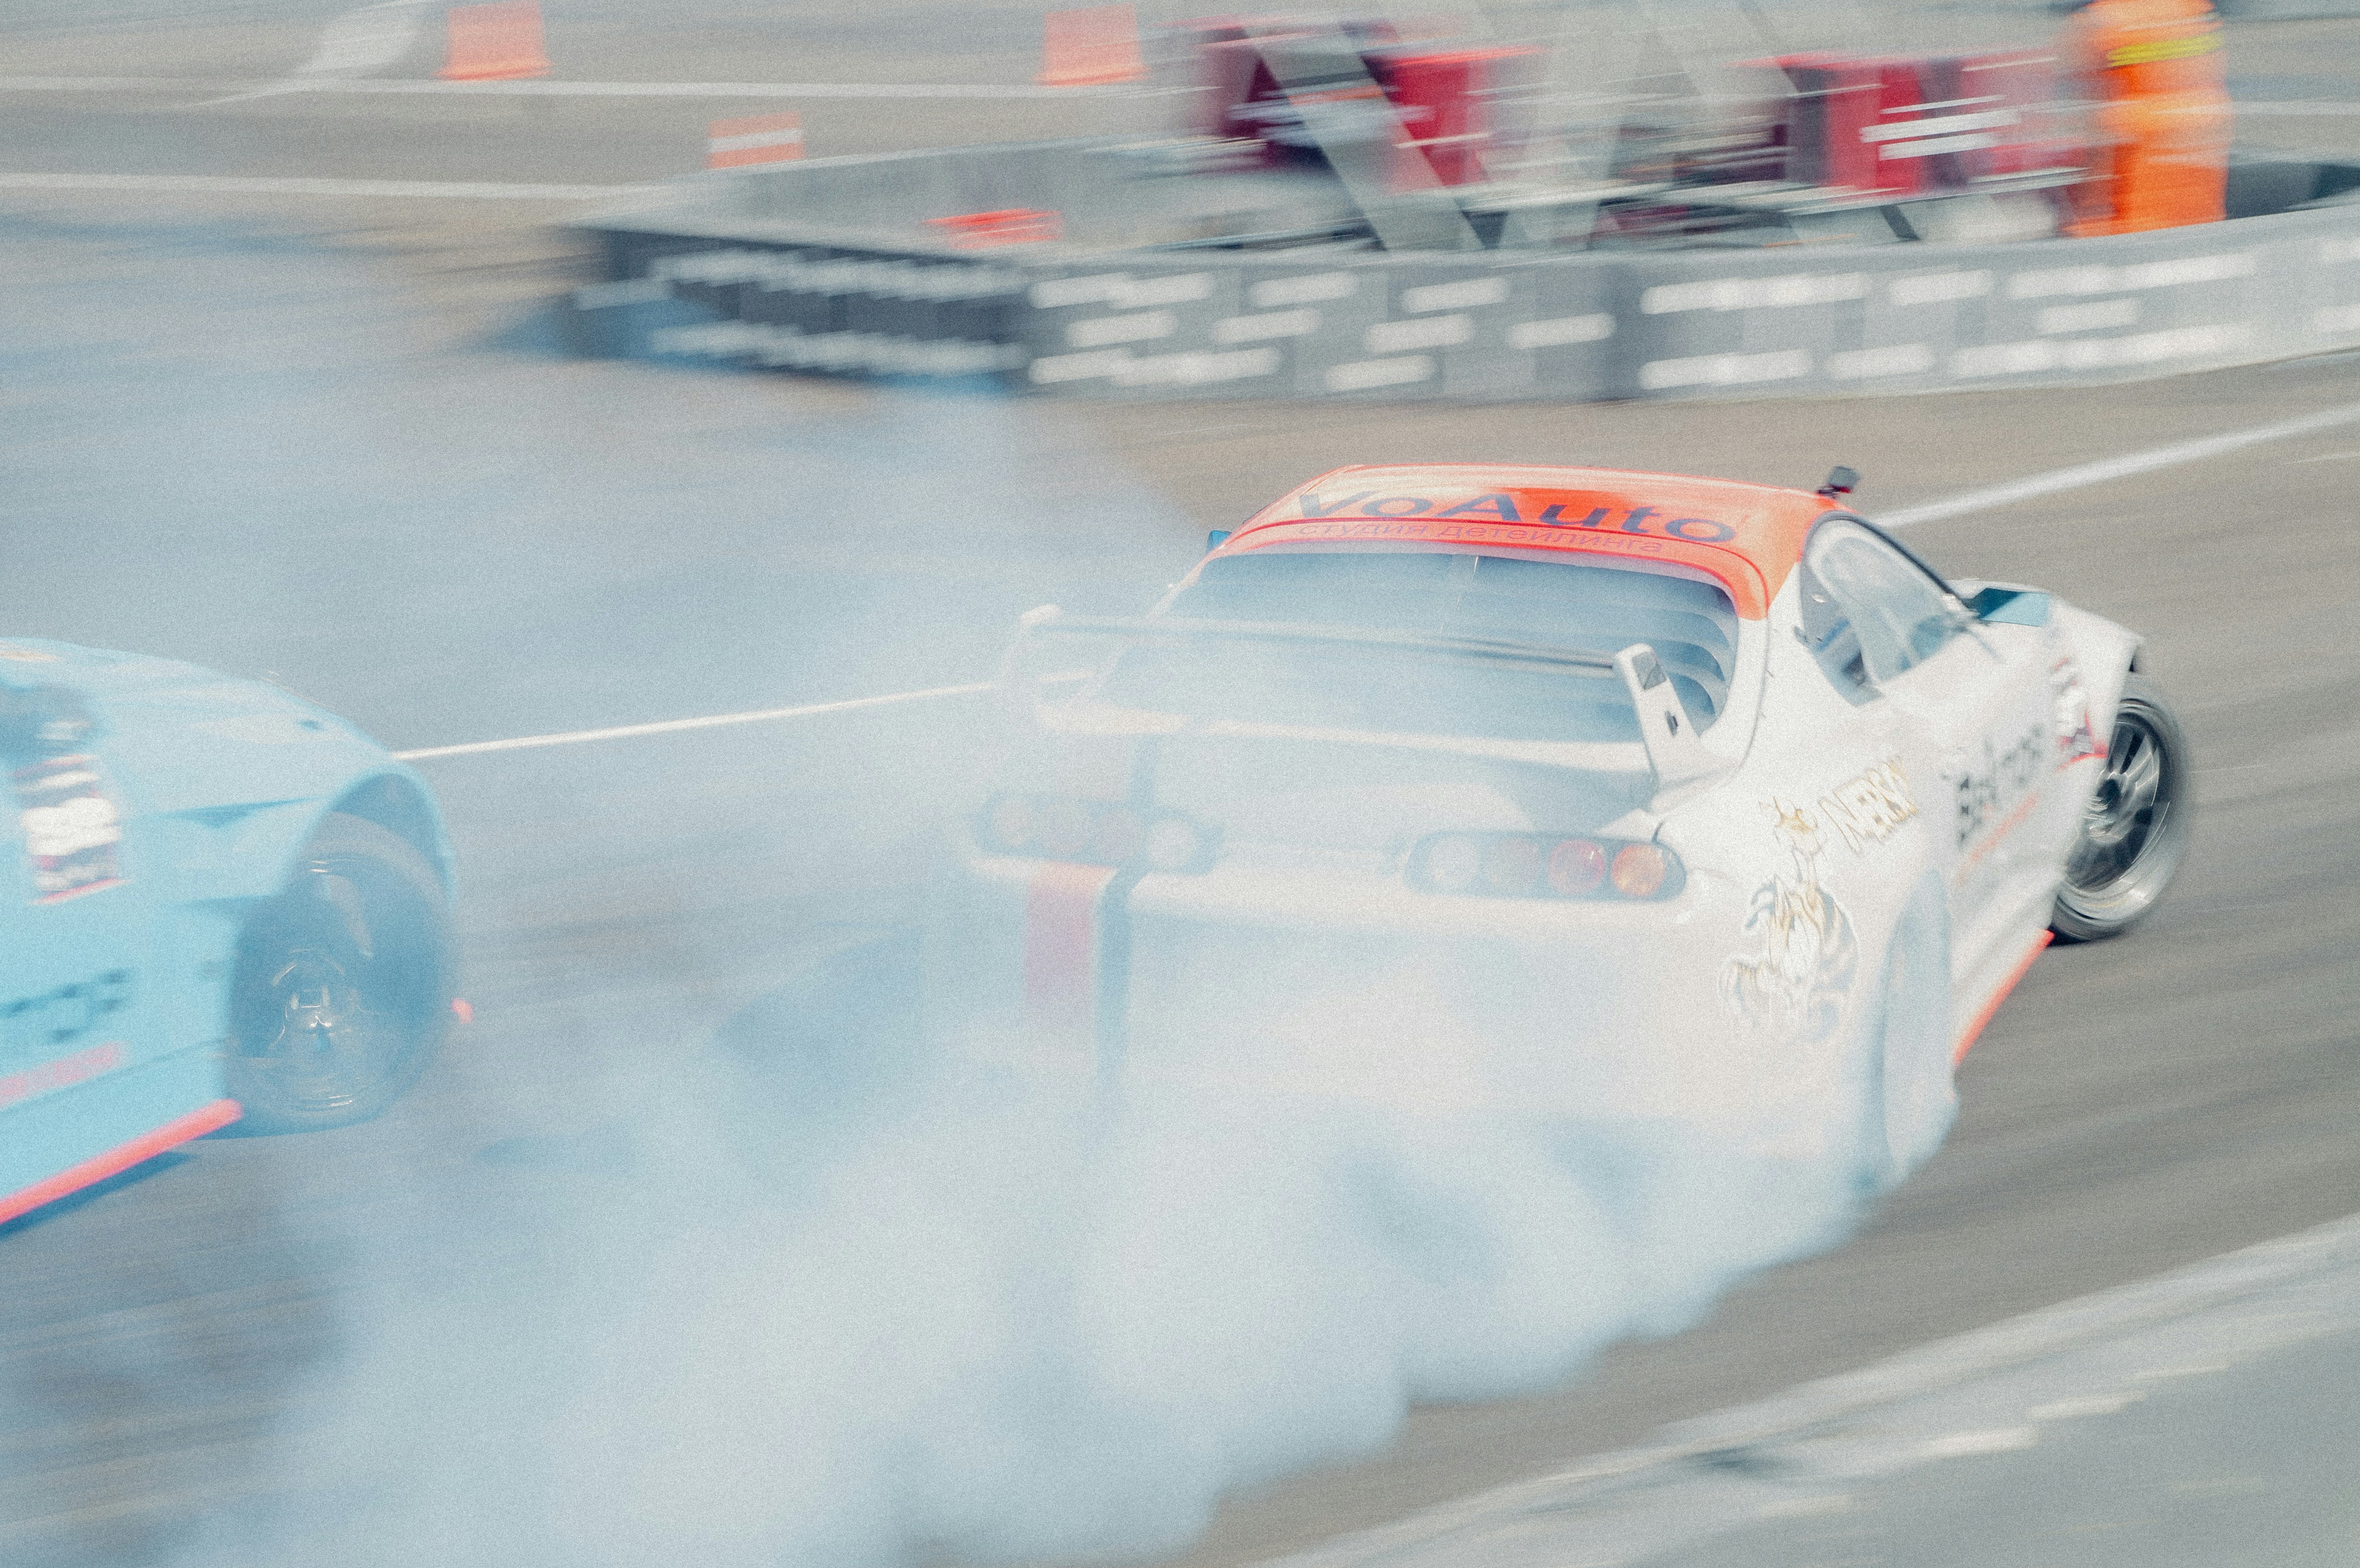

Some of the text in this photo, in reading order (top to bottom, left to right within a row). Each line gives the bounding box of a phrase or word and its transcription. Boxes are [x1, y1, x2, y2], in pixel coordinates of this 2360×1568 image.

[1299, 490, 1735, 543] VoAuto
[1299, 524, 1662, 552] студия детейлинга
